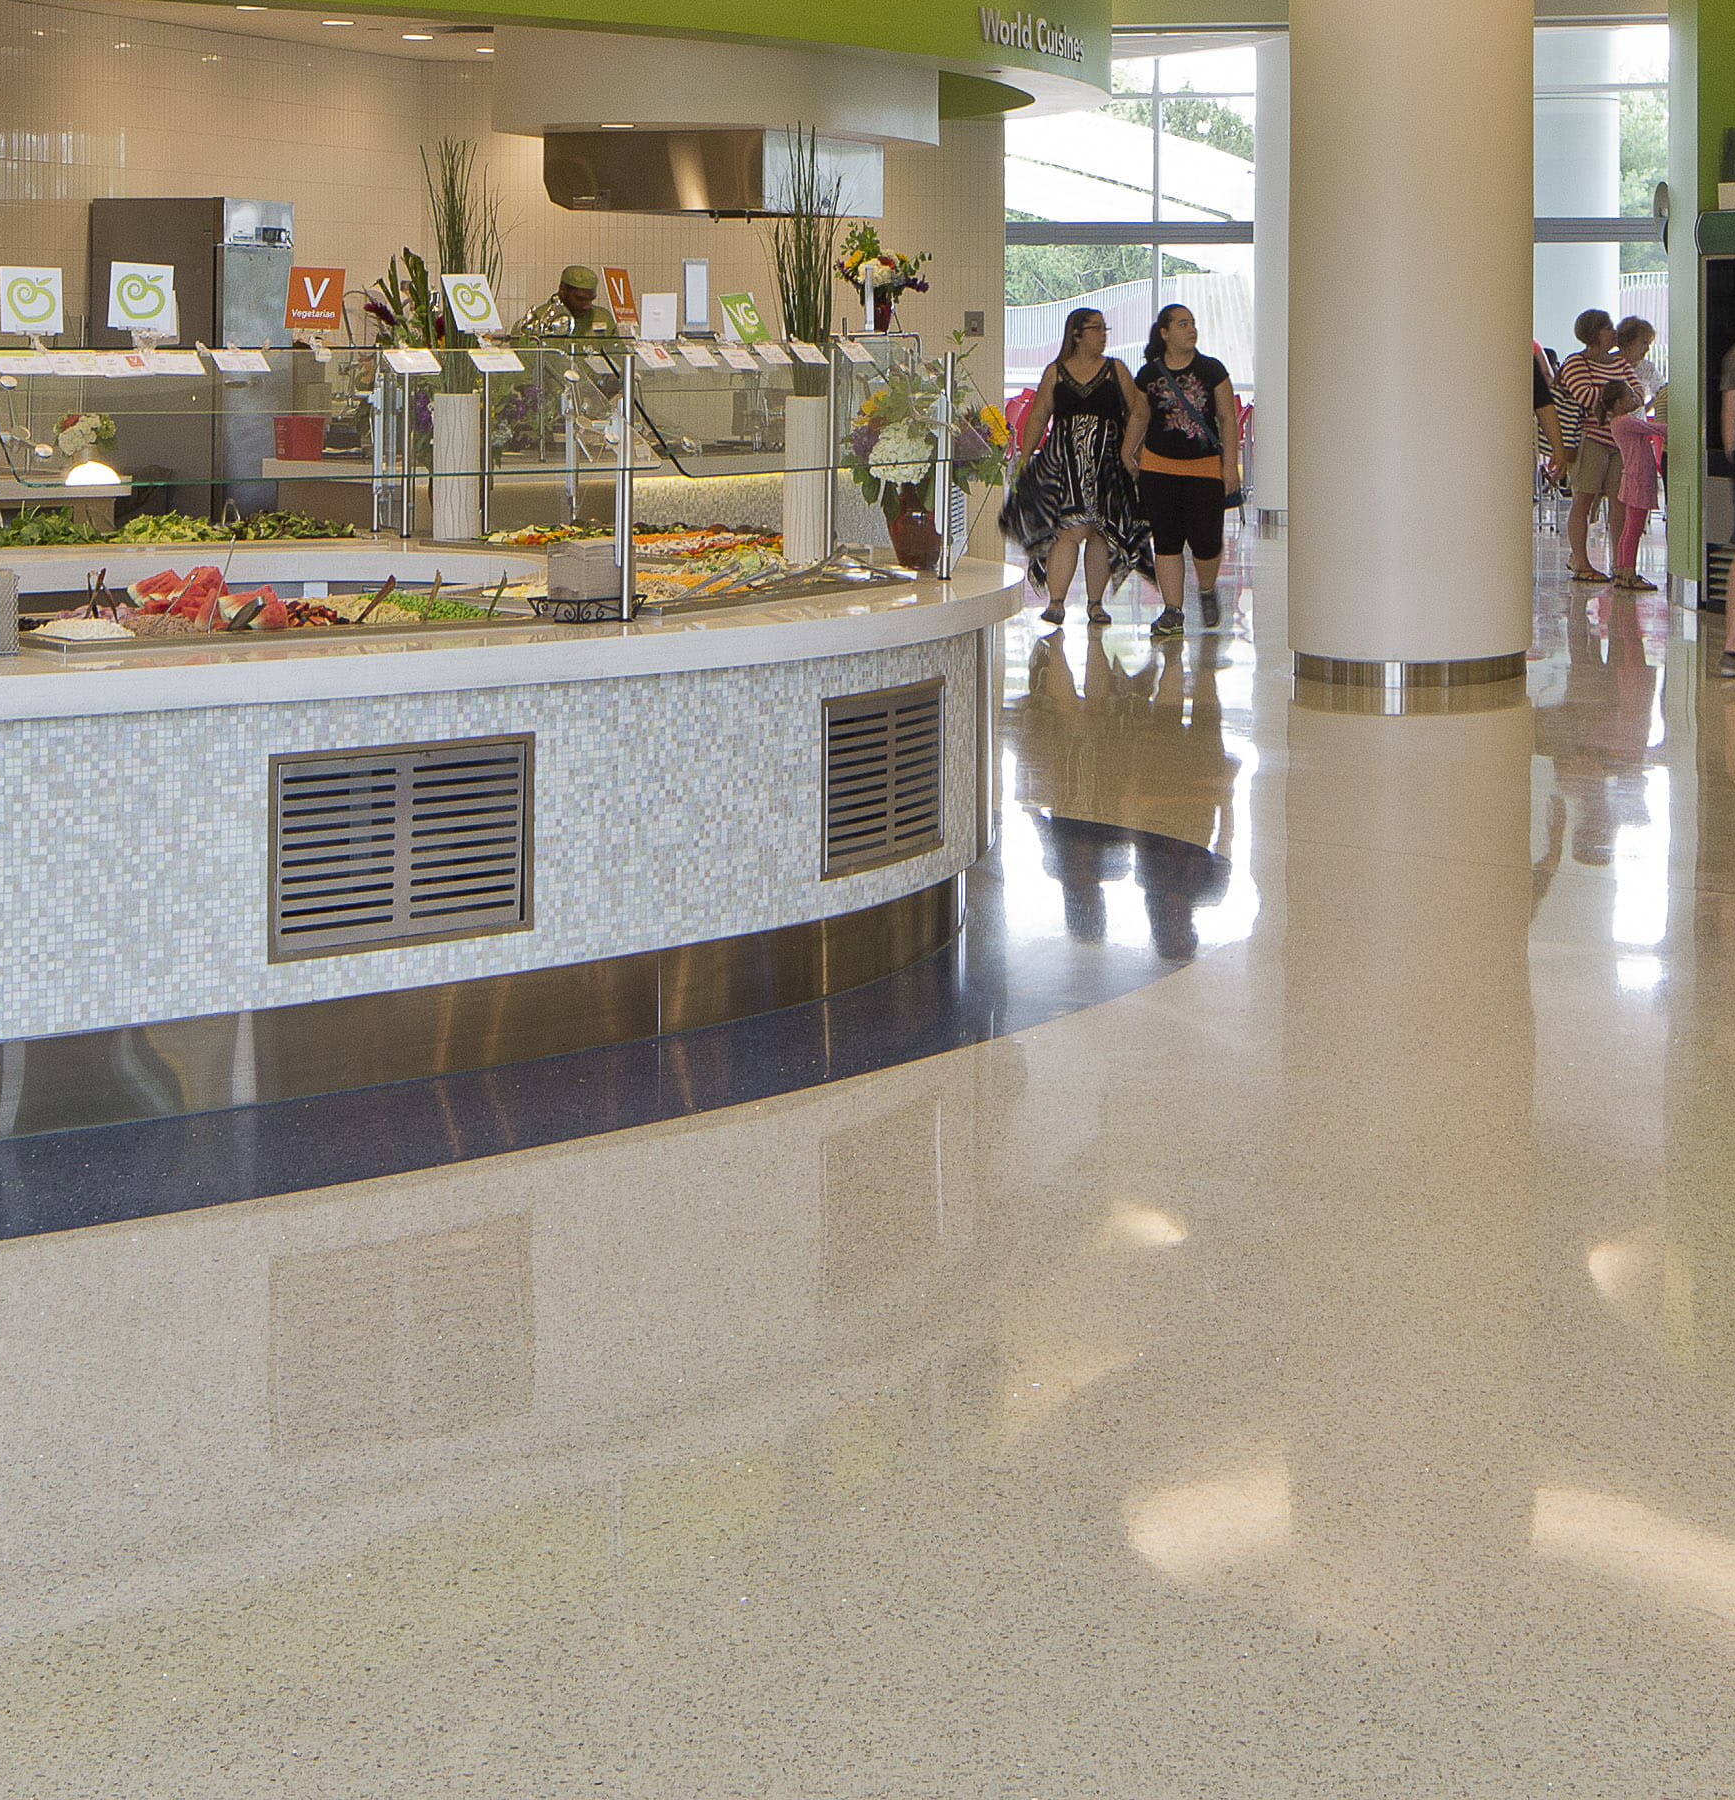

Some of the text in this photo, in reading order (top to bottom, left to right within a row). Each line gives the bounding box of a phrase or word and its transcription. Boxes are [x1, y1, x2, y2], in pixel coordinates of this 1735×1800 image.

[979, 6, 1085, 62] World Cuisines
[304, 277, 330, 308] V
[611, 277, 624, 305] V
[291, 308, 335, 319] Vegetarian
[726, 303, 759, 326] VG
